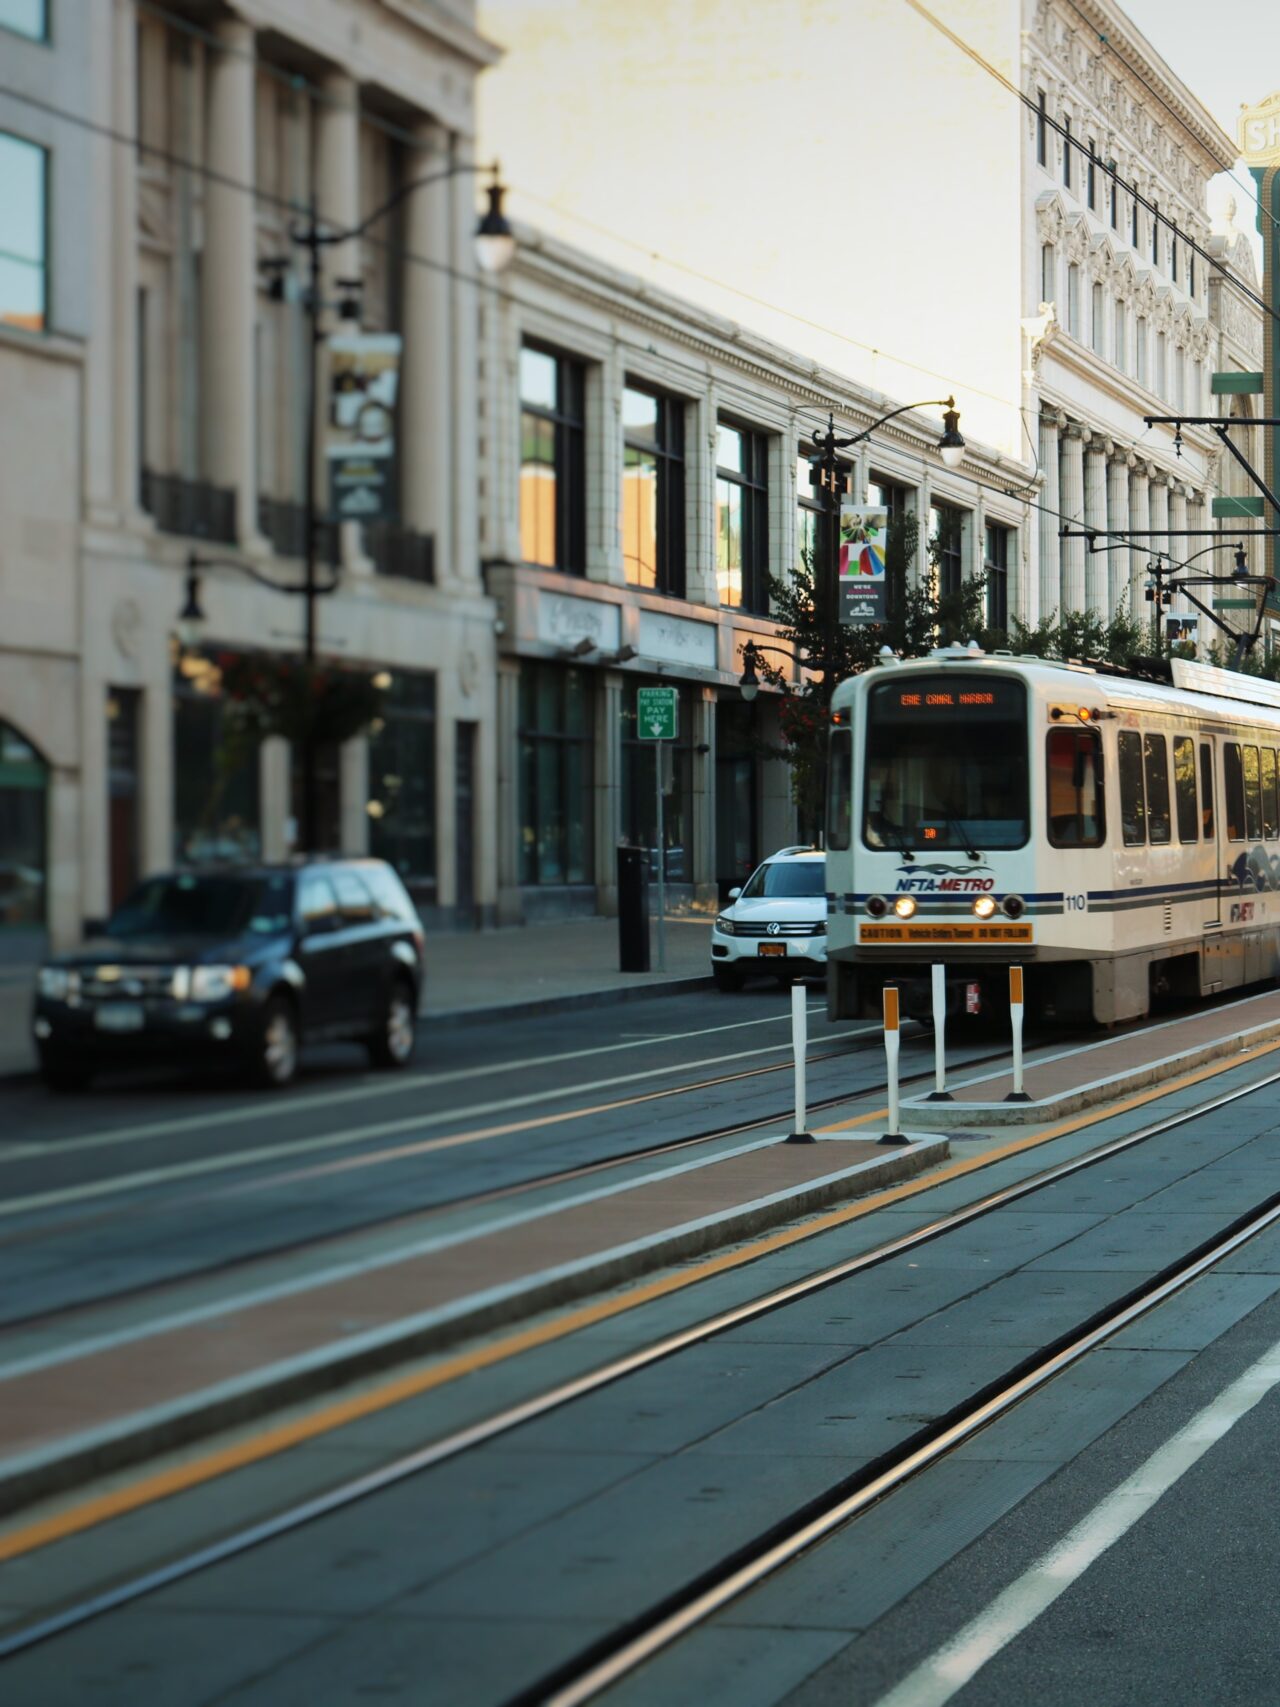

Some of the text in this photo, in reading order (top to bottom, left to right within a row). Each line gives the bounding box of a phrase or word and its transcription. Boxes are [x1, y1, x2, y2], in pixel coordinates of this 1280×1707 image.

[900, 694, 922, 705] ERIE
[926, 693, 954, 705] CANAL
[646, 706, 665, 714] PAY
[644, 715, 669, 723] HERE
[895, 878, 995, 891] NFTA-METRO
[1066, 894, 1086, 911] 110
[860, 928, 902, 938] CAUTION
